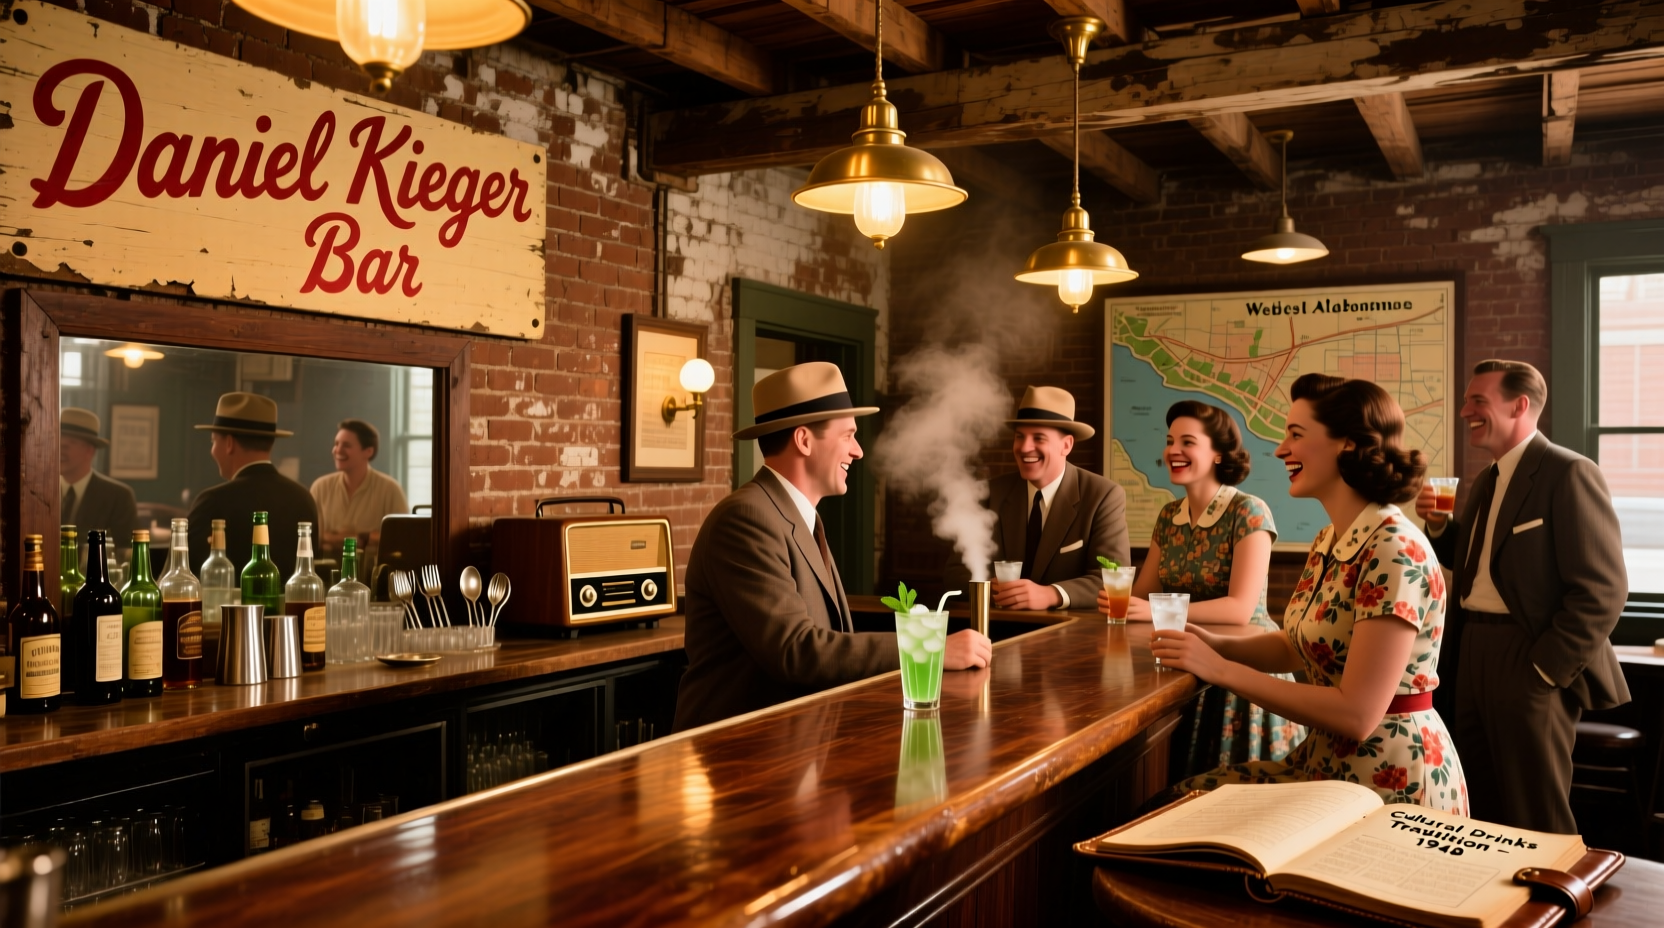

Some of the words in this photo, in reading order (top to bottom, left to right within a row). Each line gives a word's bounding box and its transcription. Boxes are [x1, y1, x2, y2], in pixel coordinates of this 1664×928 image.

[31, 58, 337, 209] Daniel
[347, 115, 533, 249] Kieger
[299, 212, 423, 298] Bar
[1469, 828, 1539, 850] Drinks
